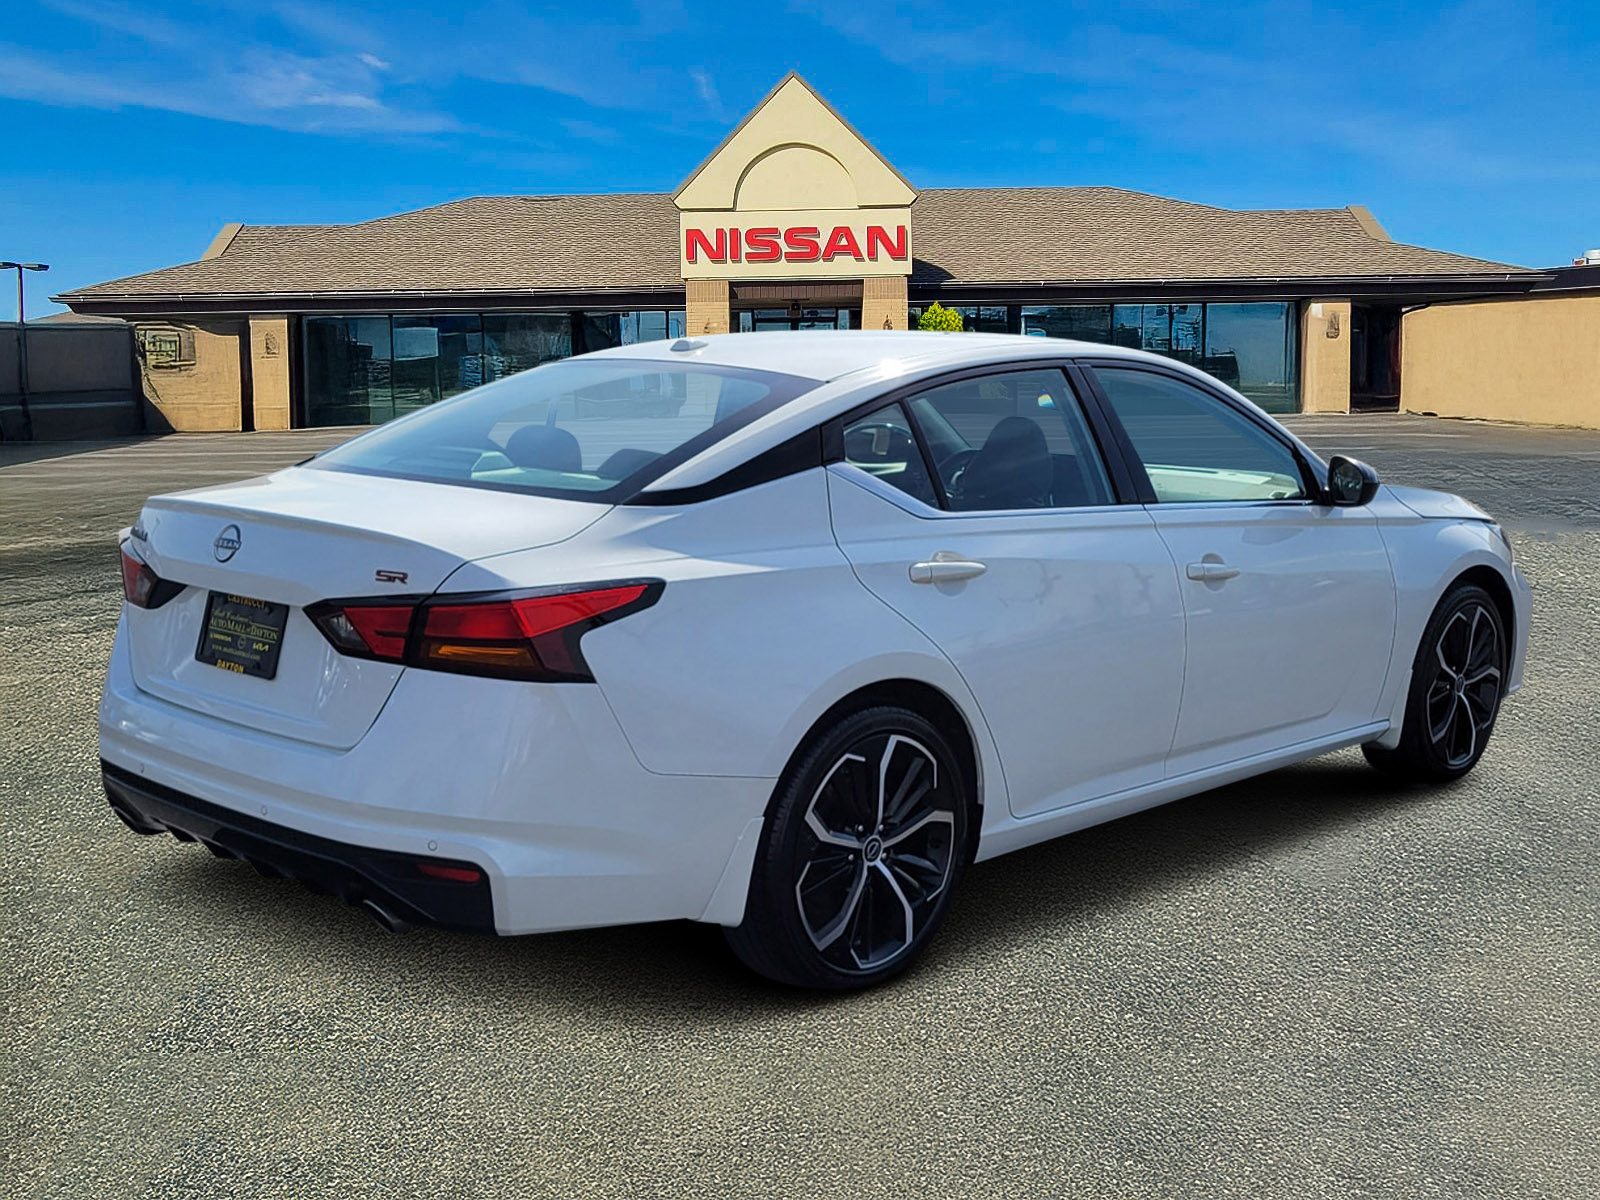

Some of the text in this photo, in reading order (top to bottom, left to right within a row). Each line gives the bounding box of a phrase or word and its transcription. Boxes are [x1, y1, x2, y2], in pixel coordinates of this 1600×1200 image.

[685, 225, 908, 264] NISSAN
[375, 569, 408, 585] SR
[216, 659, 244, 674] DAYTON
